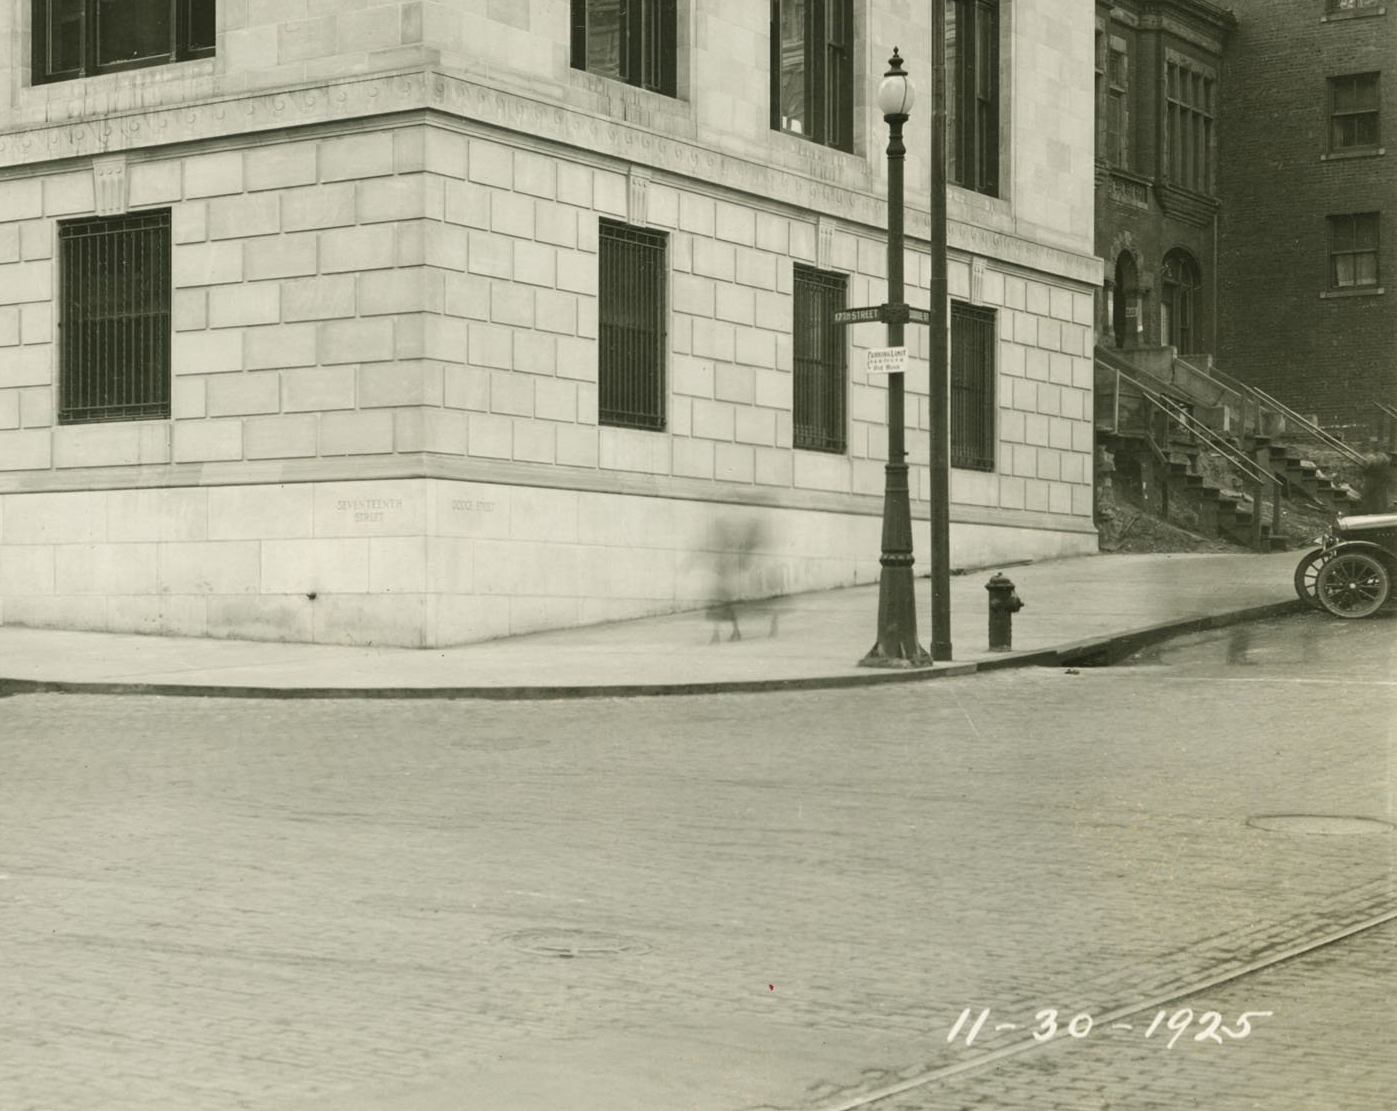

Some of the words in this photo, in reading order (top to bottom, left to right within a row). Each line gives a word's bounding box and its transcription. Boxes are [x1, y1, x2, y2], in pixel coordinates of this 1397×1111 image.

[851, 309, 879, 320] STREET
[337, 498, 403, 511] SEVENTEENTH
[355, 512, 384, 523] STREET
